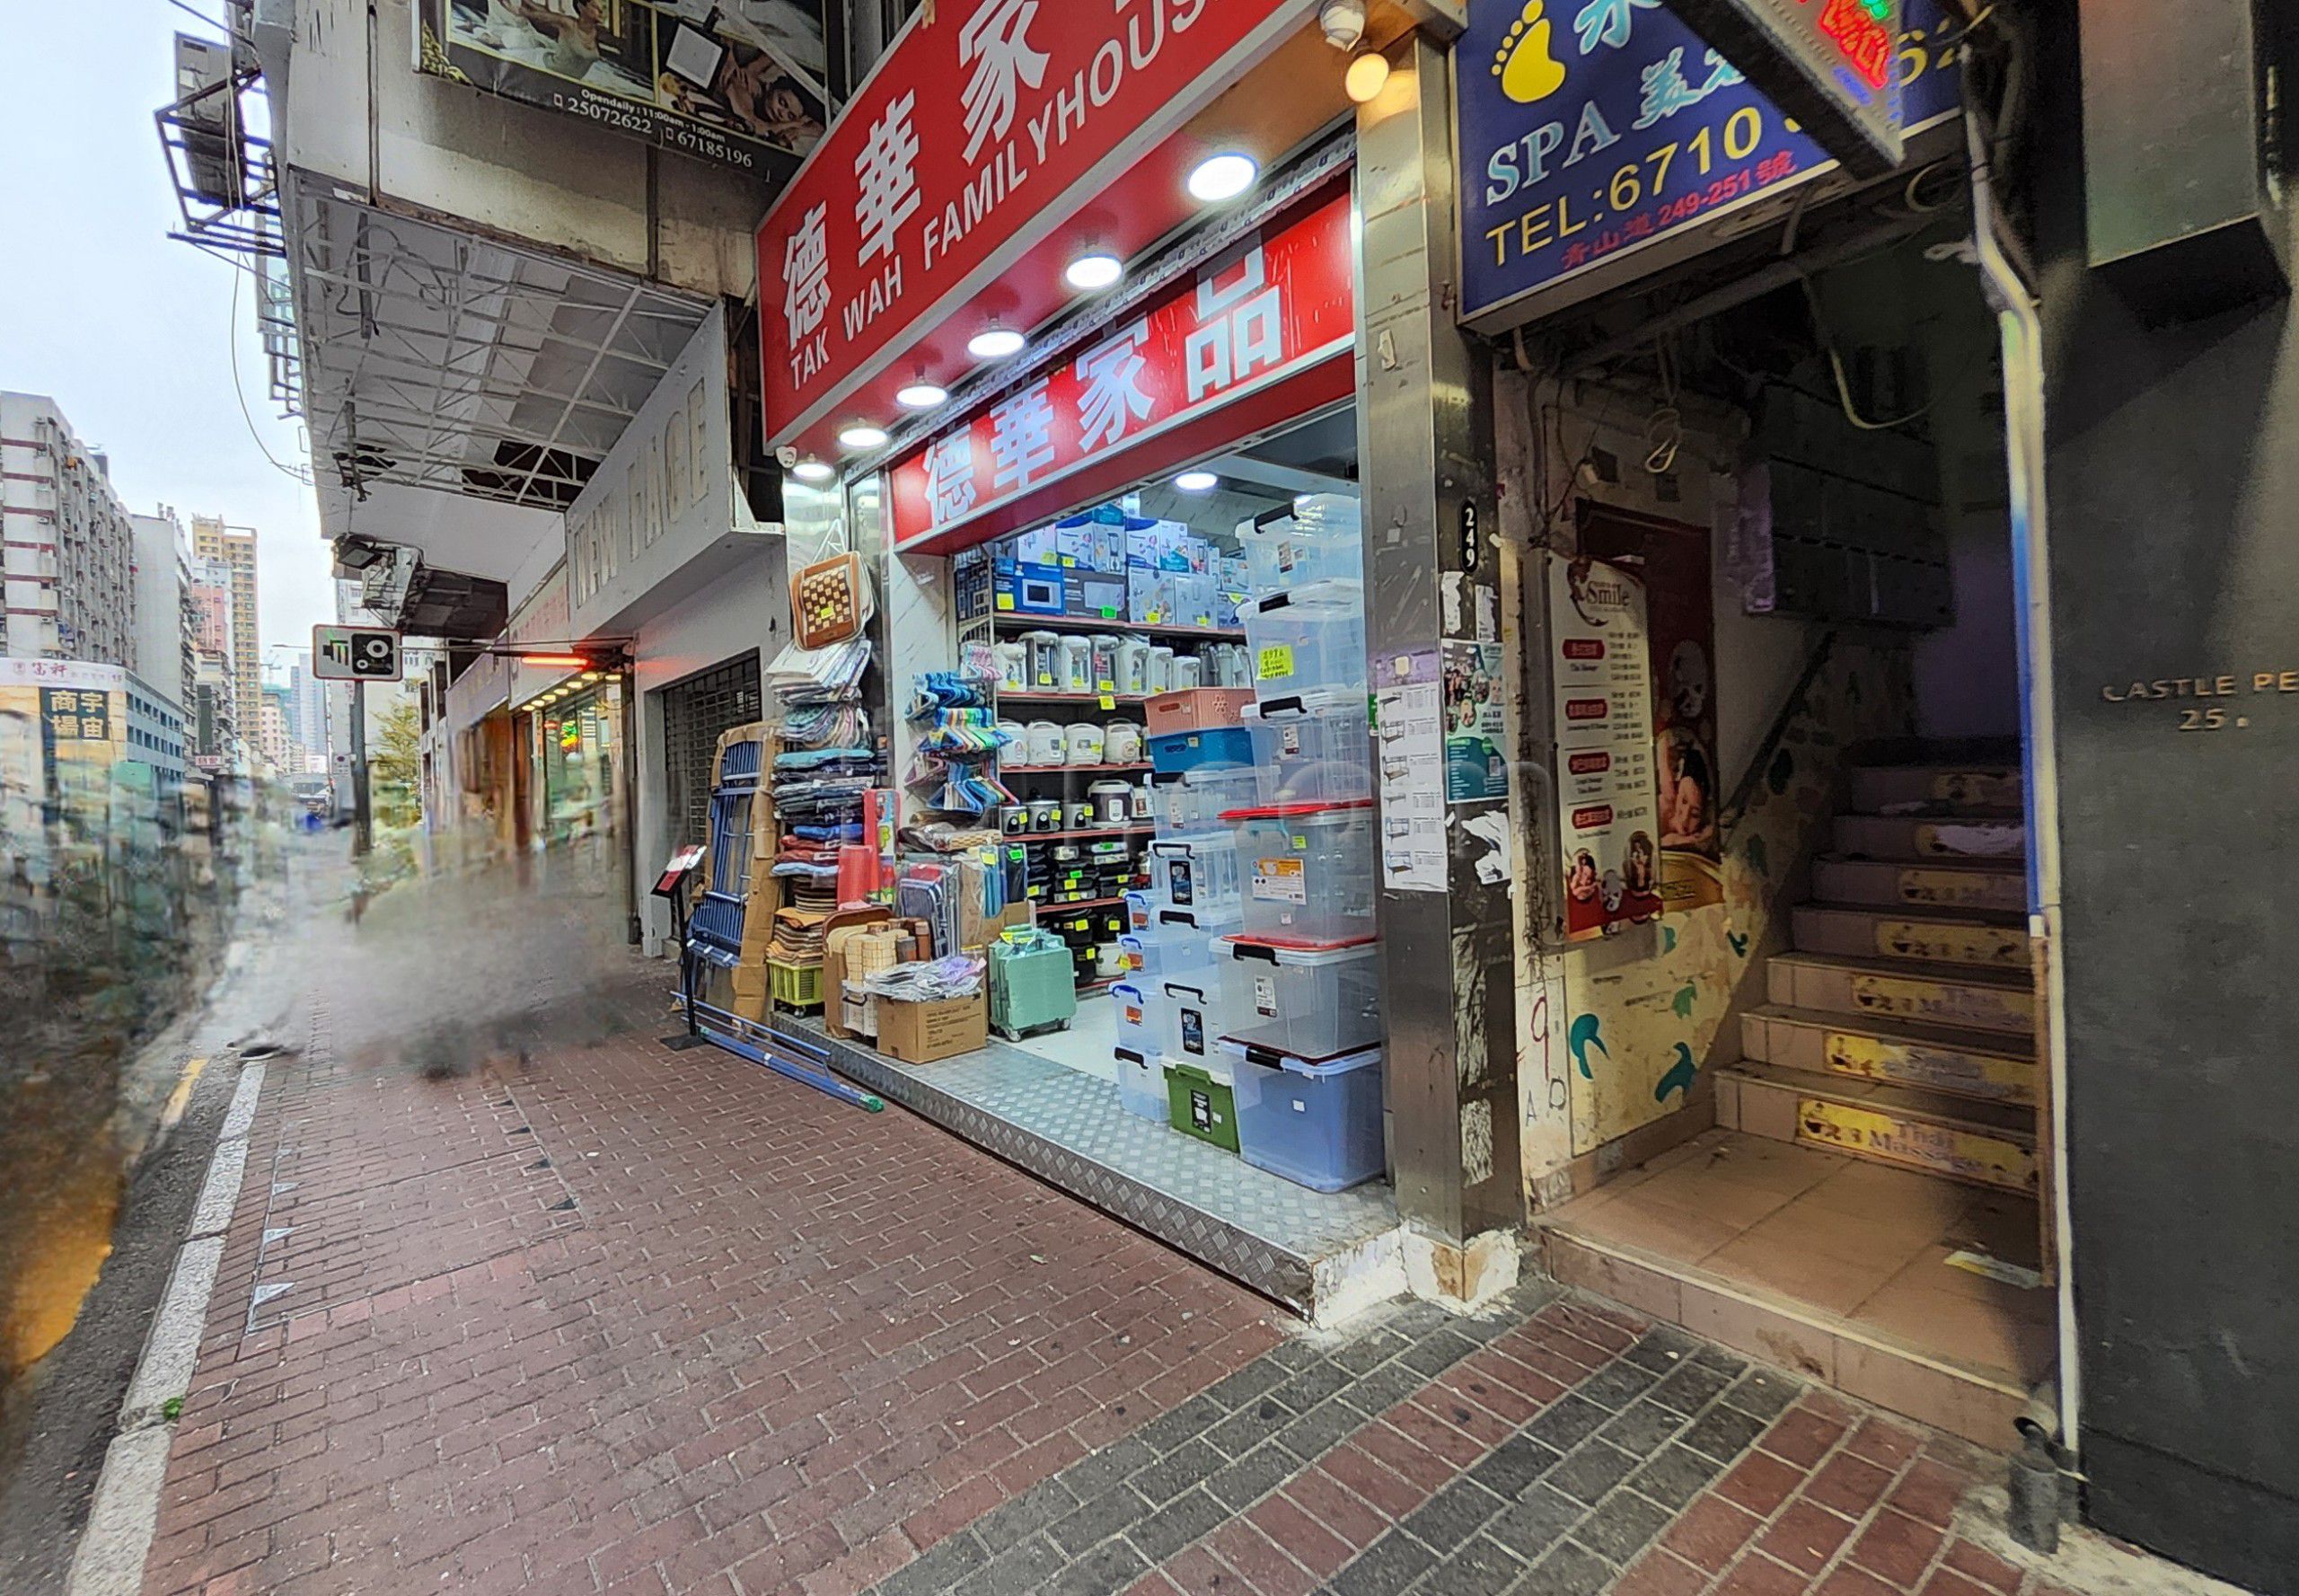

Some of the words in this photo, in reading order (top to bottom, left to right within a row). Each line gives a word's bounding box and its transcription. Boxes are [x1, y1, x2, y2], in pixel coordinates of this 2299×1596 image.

[567, 96, 653, 136] 25072622
[677, 129, 753, 169] 67185196
[782, 0, 1133, 350] 德華家
[1486, 99, 1622, 207] SPA
[790, 328, 831, 391] TAK
[842, 254, 903, 342] WAH
[923, 235, 1282, 529] 德華家品
[1464, 507, 1475, 568] 249
[1585, 580, 1630, 607] Smile
[2101, 675, 2239, 702] CASTLE
